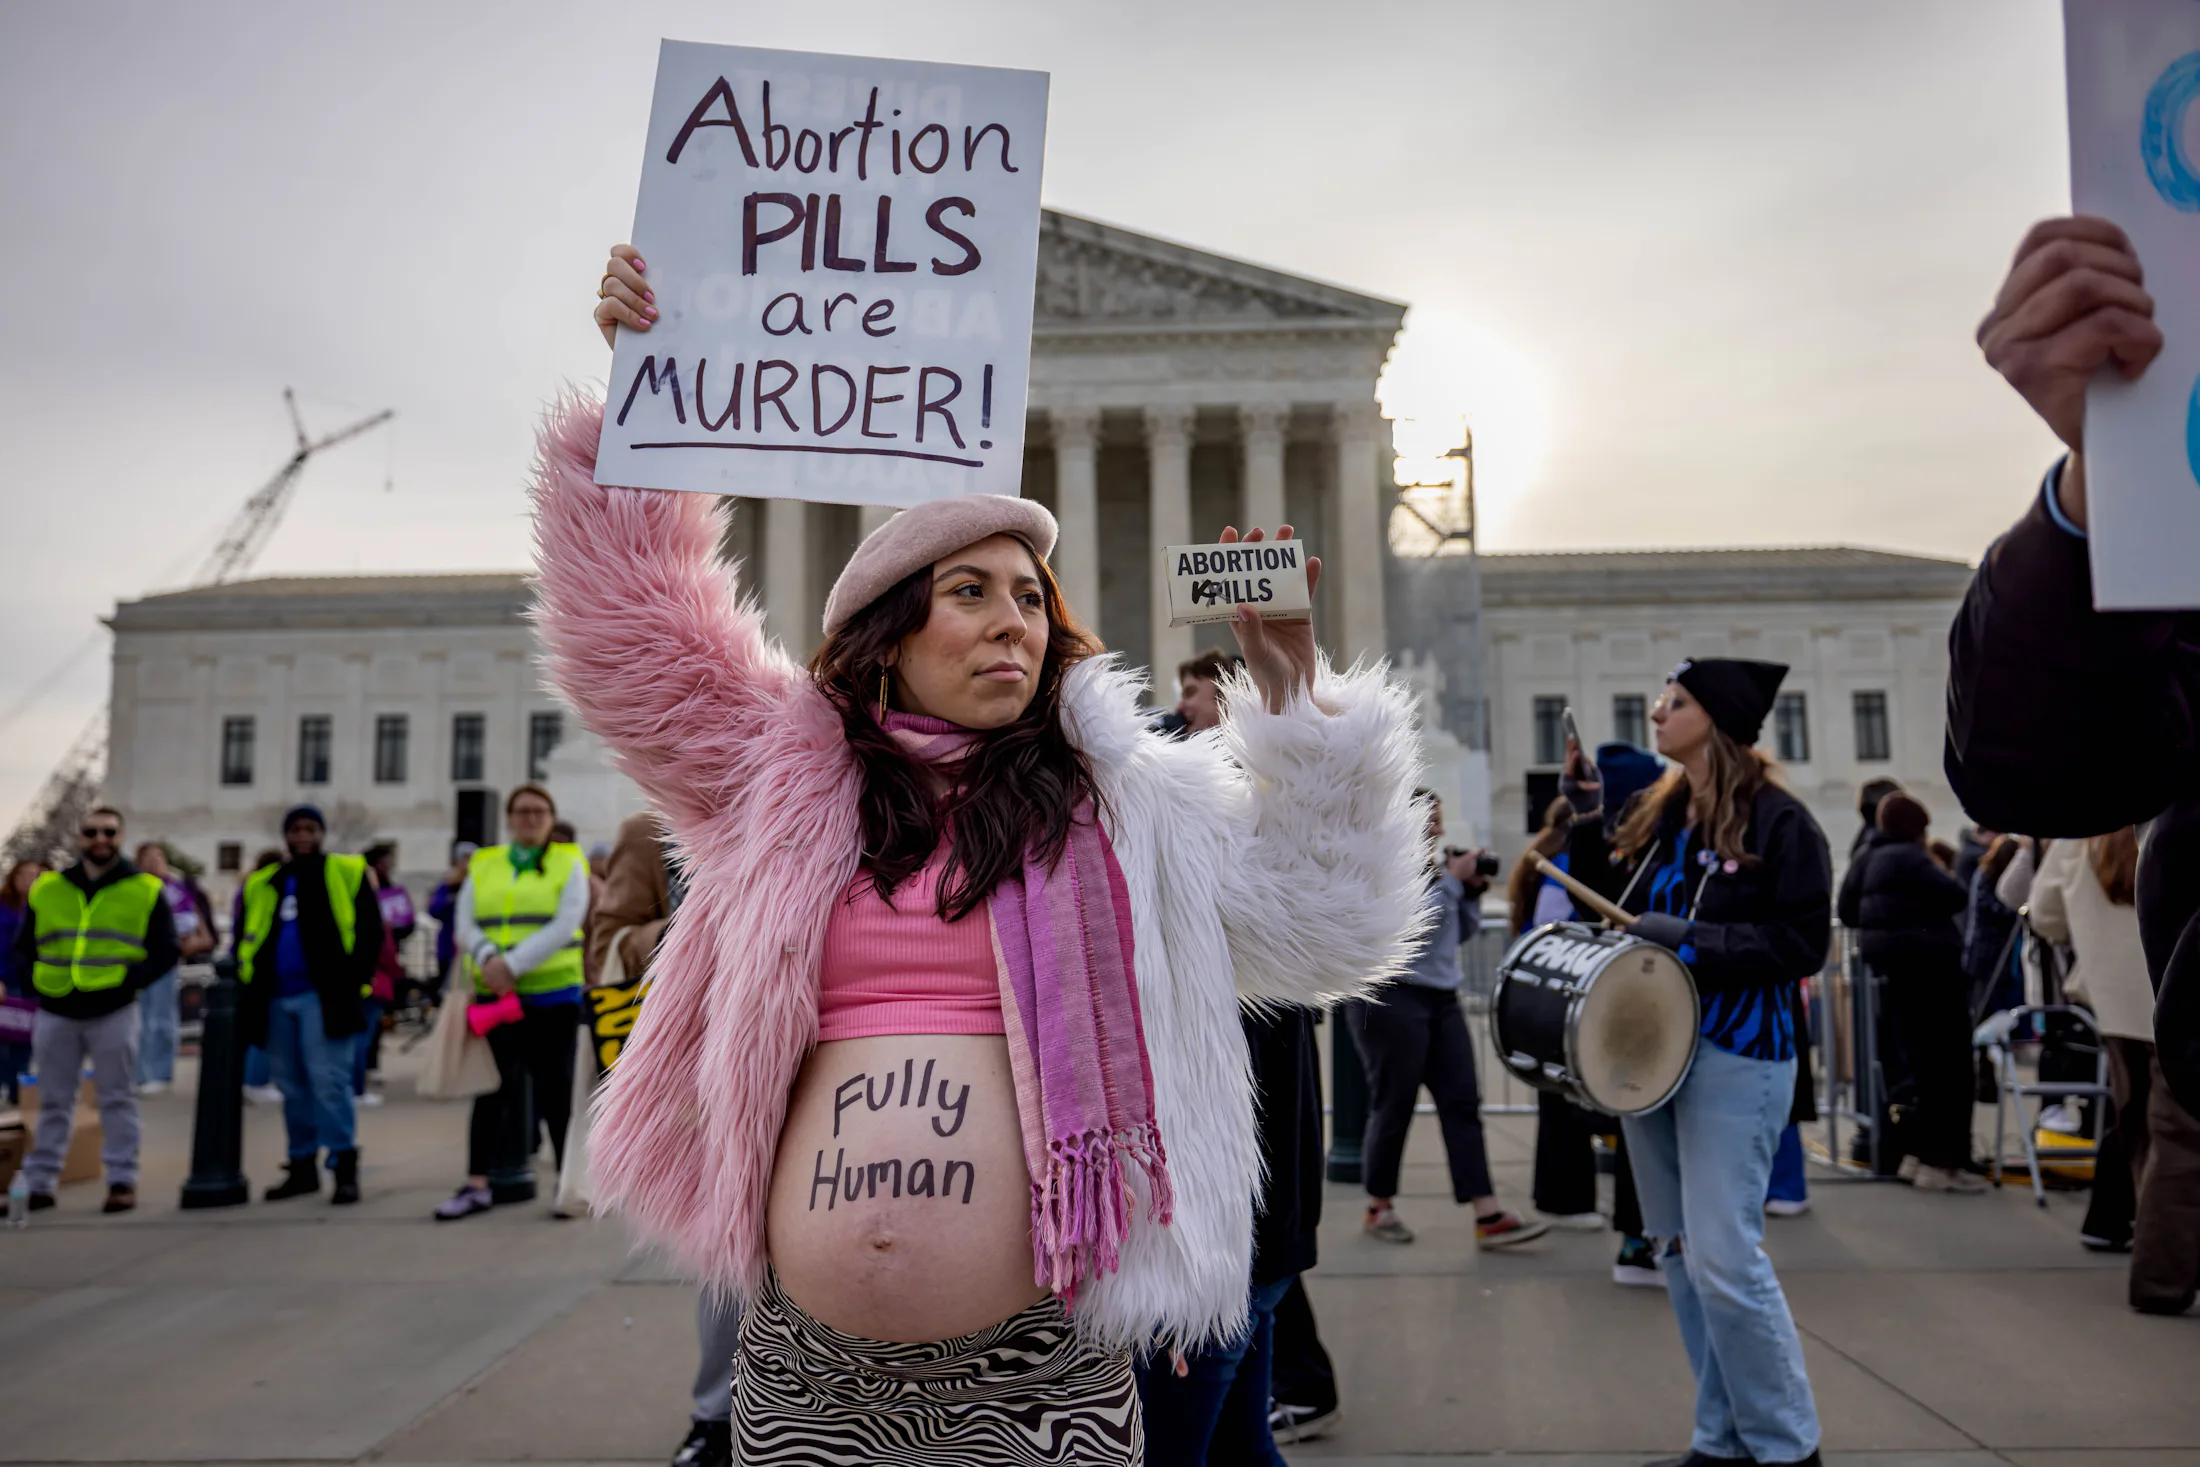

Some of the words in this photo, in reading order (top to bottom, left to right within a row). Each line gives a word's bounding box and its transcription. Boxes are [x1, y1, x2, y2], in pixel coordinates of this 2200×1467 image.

[666, 75, 1019, 180] Abortion
[742, 191, 982, 276] PILLS
[762, 292, 897, 337] are
[616, 355, 994, 449] MURDER!
[1177, 547, 1297, 576] ABORTION
[833, 1058, 971, 1139] Fully
[809, 1147, 975, 1212] Human
